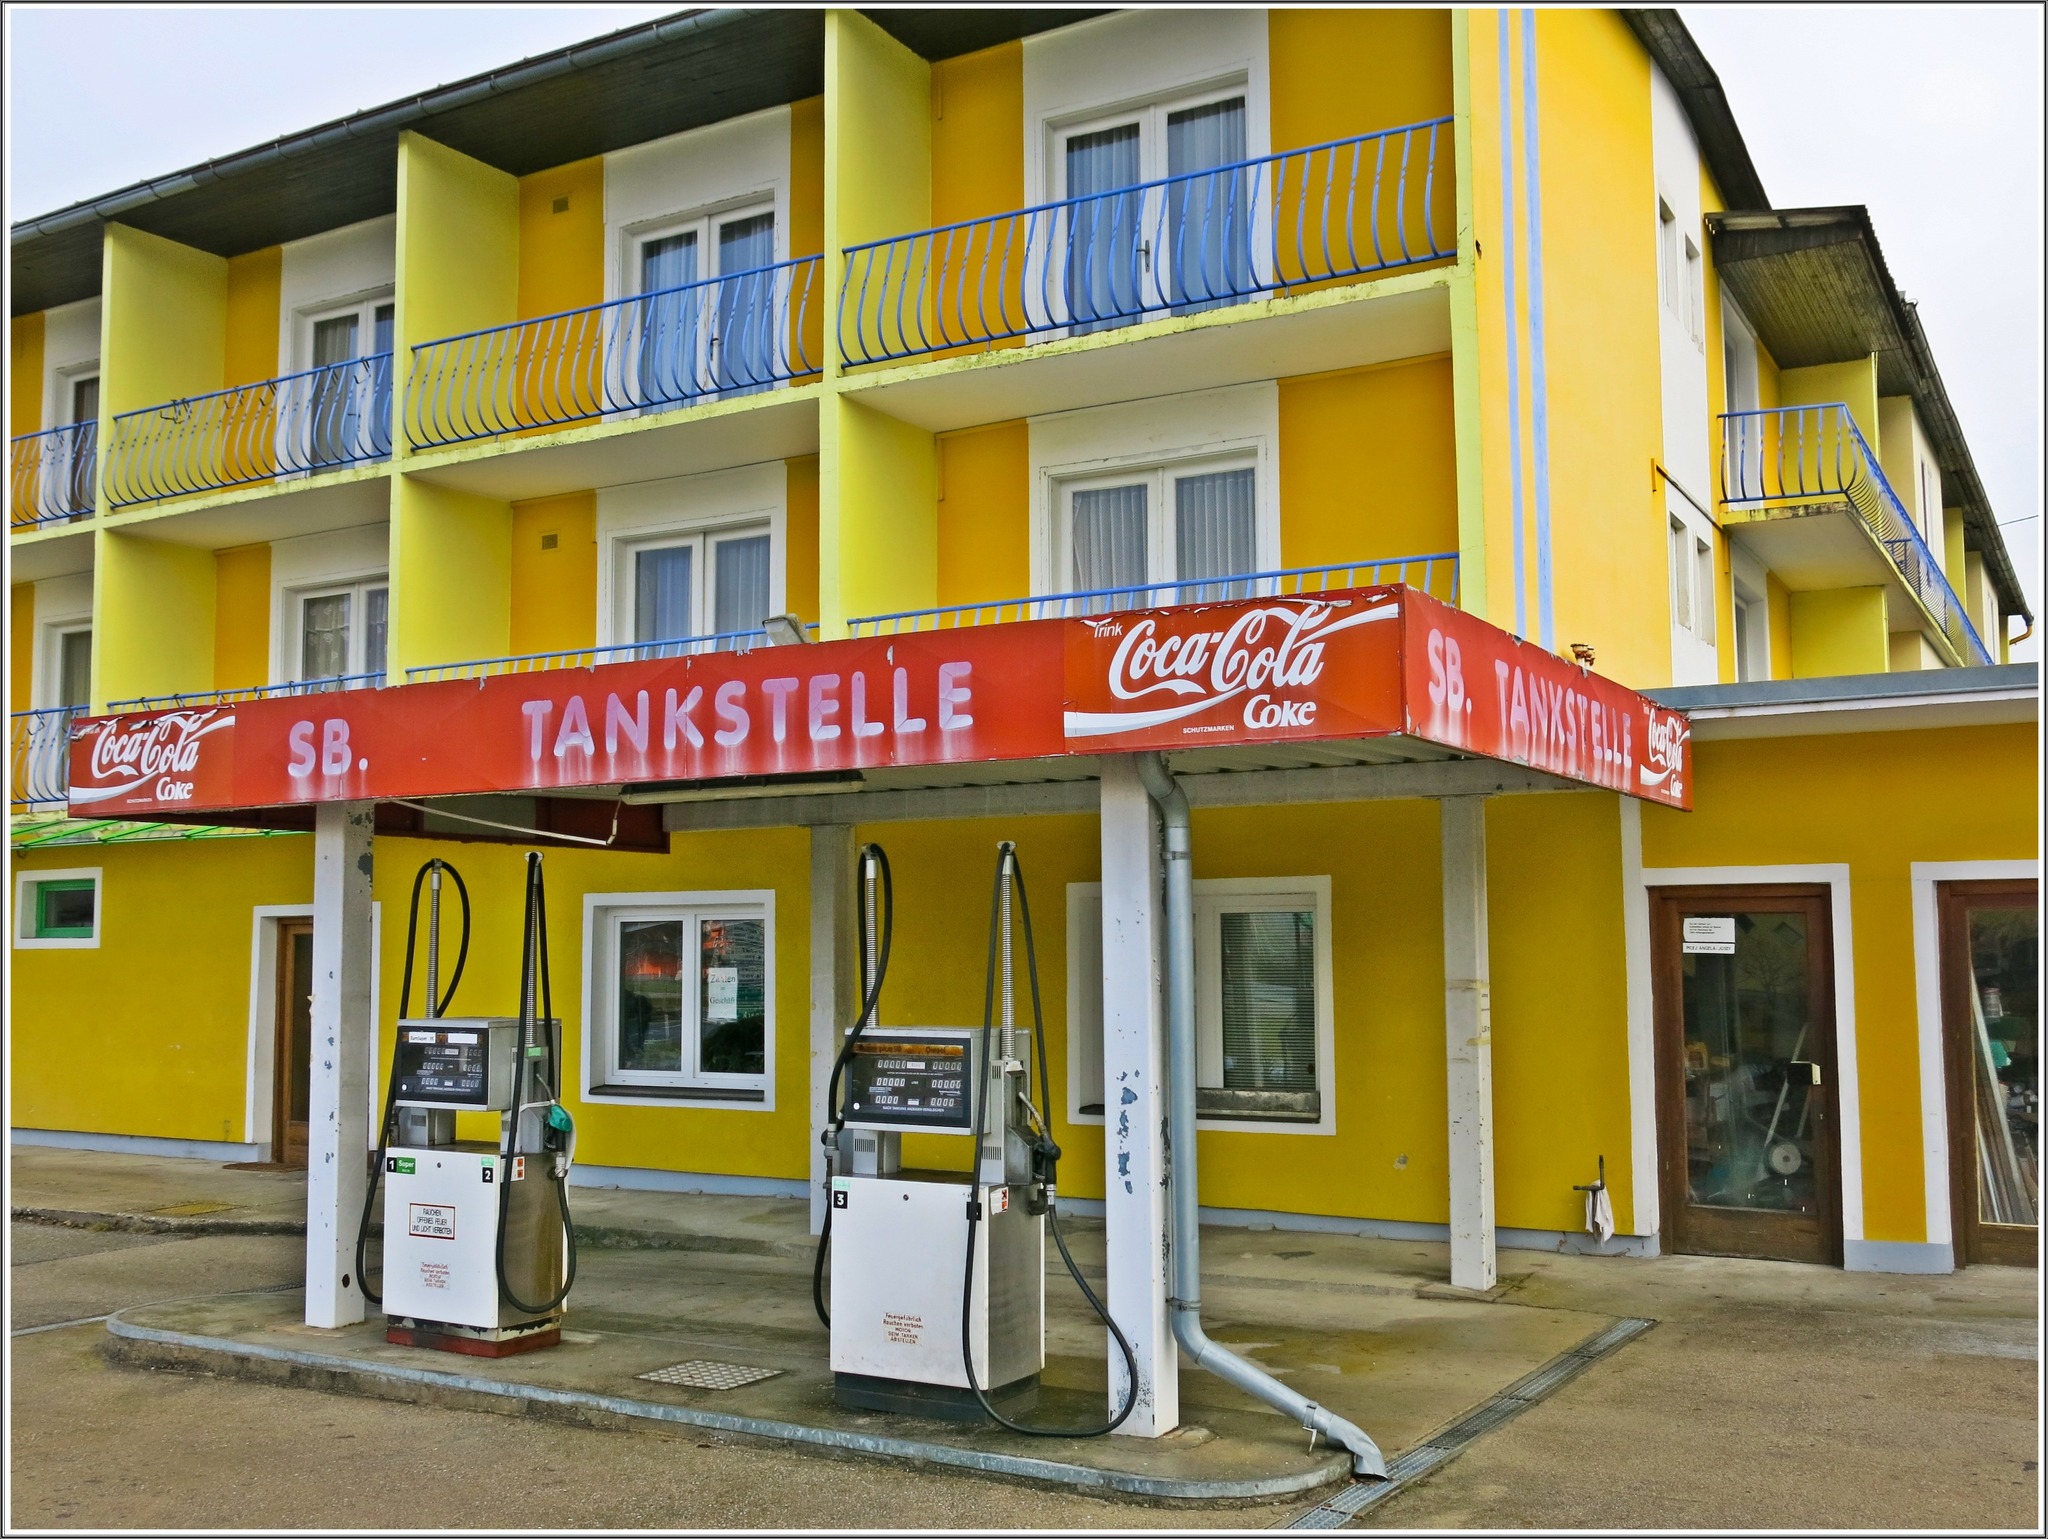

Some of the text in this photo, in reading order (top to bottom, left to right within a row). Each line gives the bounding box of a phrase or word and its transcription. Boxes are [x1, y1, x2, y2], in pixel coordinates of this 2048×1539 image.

[1108, 605, 1332, 700] Coca-Cola
[1242, 694, 1317, 729] Coke
[1427, 628, 1633, 770] SB. TANKSTELLE
[287, 661, 973, 778] SB. TANKSTELLE
[1182, 724, 1235, 734] SCHUTZMARKEN
[91, 711, 202, 779] Coca-Cola
[1648, 707, 1683, 773] Coca-Cola
[156, 776, 195, 801] Coke
[710, 974, 736, 983] Zalen
[389, 1159, 395, 1170] 1
[398, 1159, 415, 1169] Super
[485, 1170, 491, 1180] 2
[837, 1193, 844, 1206] 3
